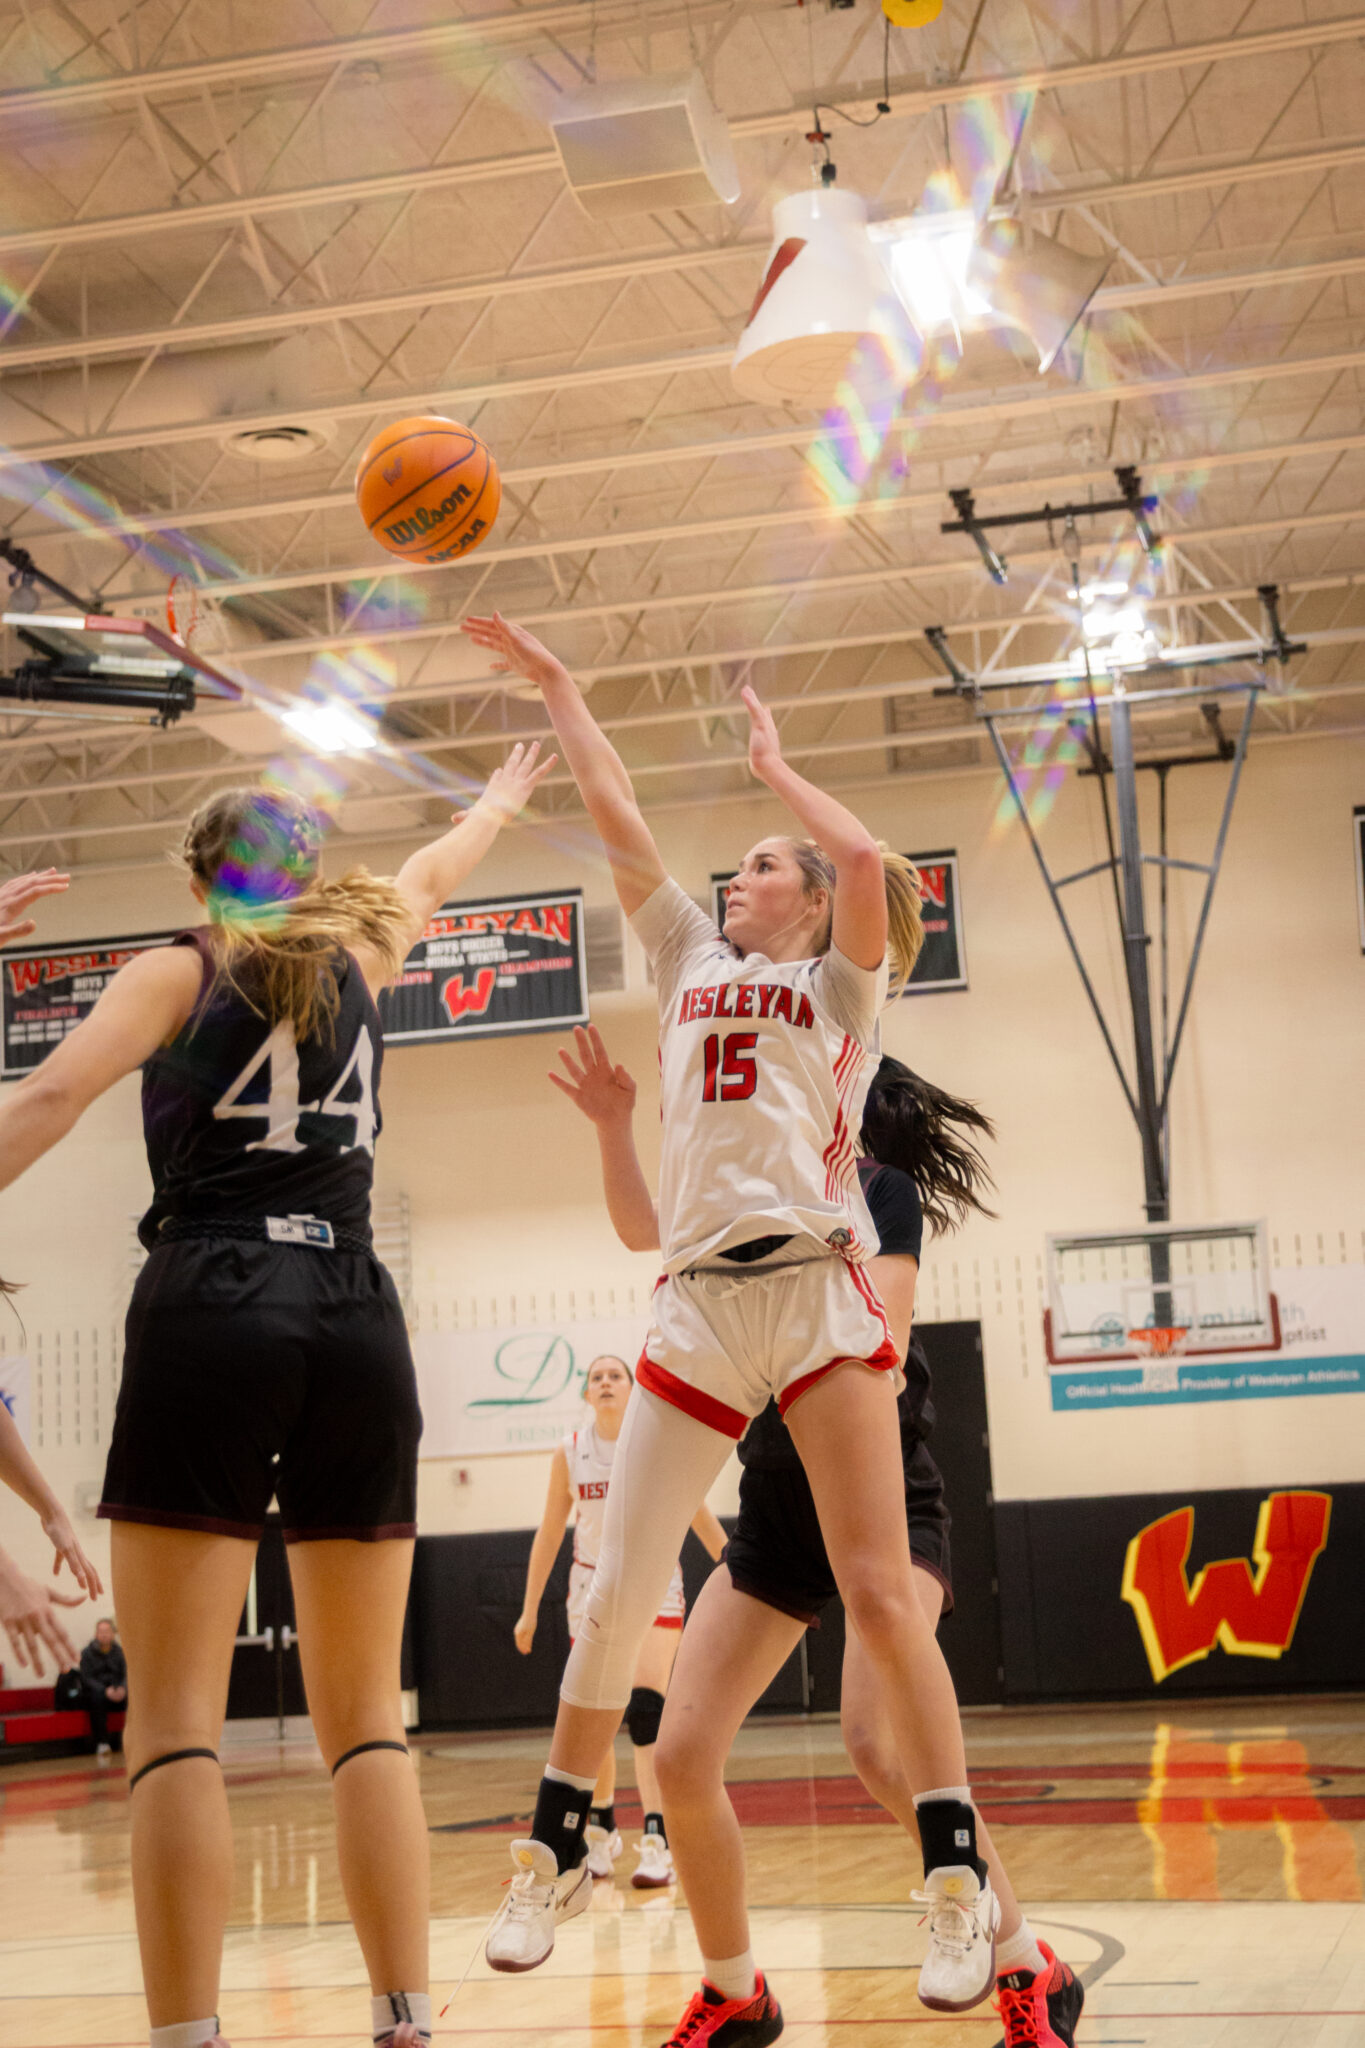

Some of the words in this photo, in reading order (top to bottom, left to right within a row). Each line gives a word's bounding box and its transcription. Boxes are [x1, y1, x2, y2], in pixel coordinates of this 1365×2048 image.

[383, 484, 472, 546] Wilson
[426, 518, 486, 563] NCAA
[439, 967, 497, 1025] W
[678, 983, 815, 1029] WESLEYAN
[212, 1018, 378, 1158] 44
[702, 1032, 759, 1102] 15
[1181, 1376, 1231, 1391] Provider
[1233, 1374, 1246, 1388] of
[1247, 1372, 1305, 1388] Wesleyan
[1307, 1369, 1360, 1384] Athletics
[1120, 1489, 1333, 1685] W
